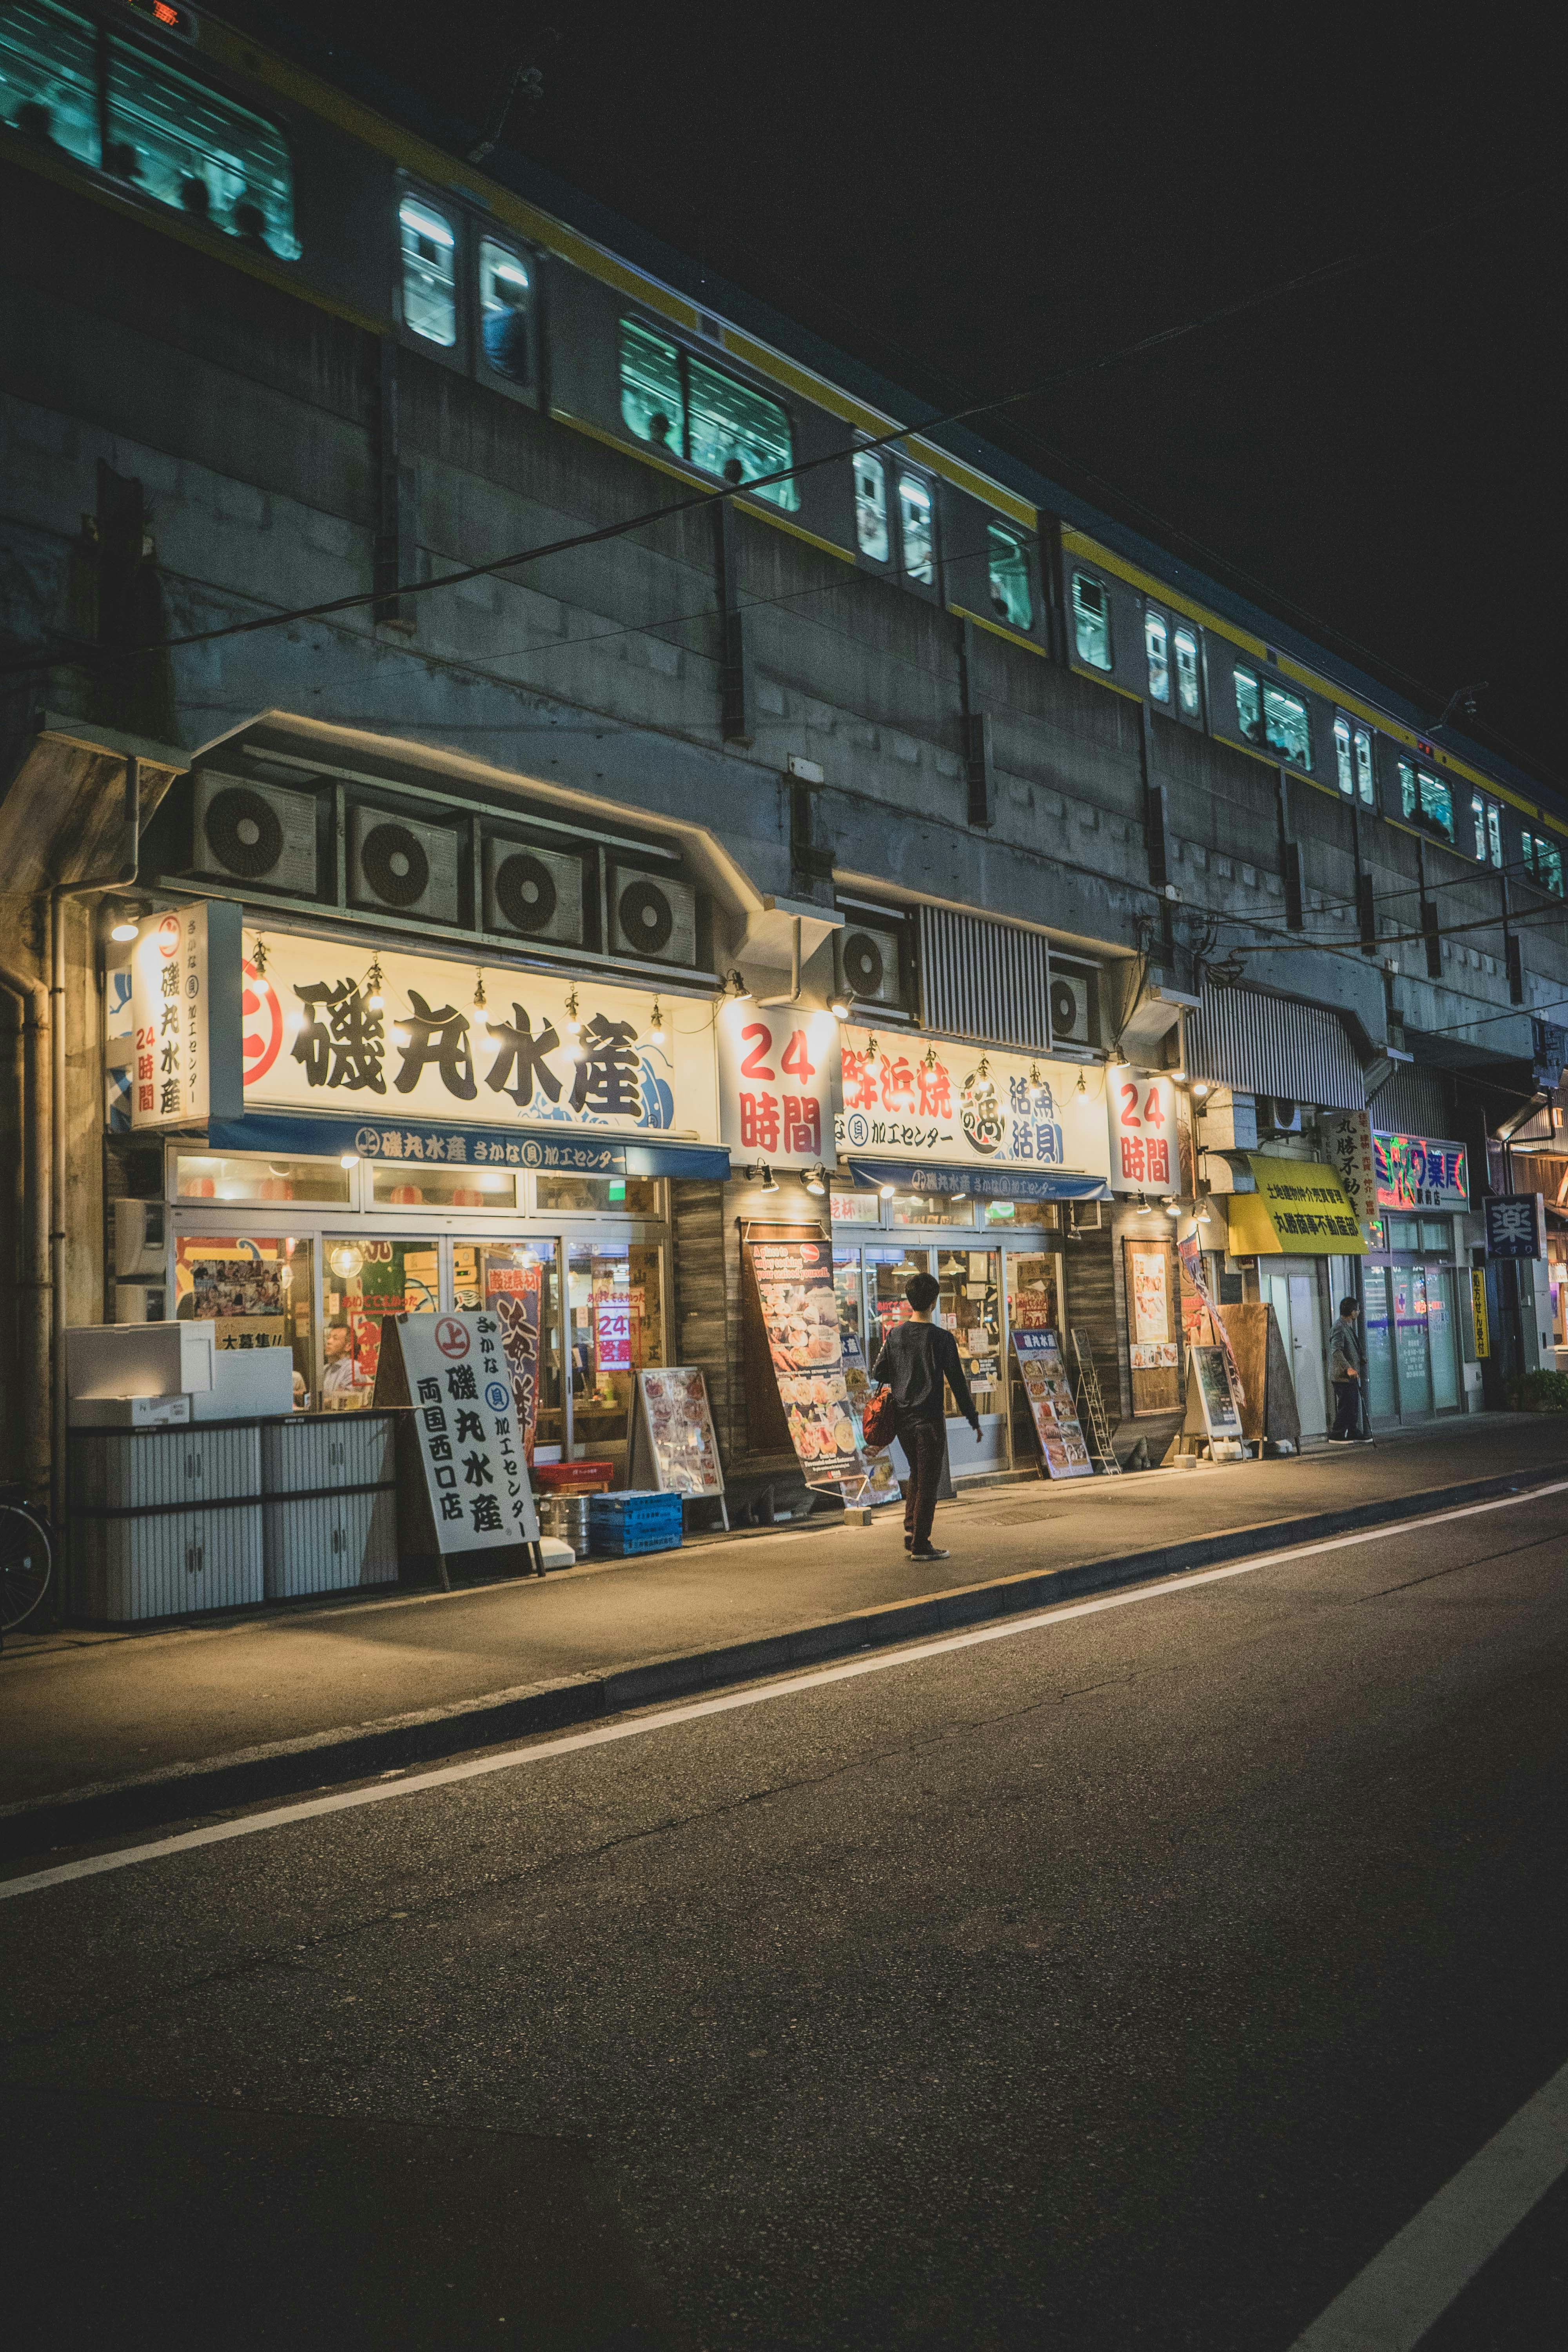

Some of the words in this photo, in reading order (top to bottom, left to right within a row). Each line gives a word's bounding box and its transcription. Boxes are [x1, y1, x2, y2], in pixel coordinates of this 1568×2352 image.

[160, 962, 181, 1116] 磯丸水産
[290, 977, 642, 1117] 磯丸水産
[741, 1023, 816, 1085] 24
[739, 1091, 822, 1156] 時間
[1120, 1082, 1165, 1131] 24
[1120, 1135, 1170, 1185] 時間
[1491, 1202, 1532, 1242] 薬
[1495, 1245, 1533, 1255] くすり
[755, 1258, 775, 1270] enjoy
[757, 1270, 773, 1281] your
[1474, 1274, 1484, 1355] 処方せん受付
[417, 1377, 465, 1521] 両国西口店
[445, 1364, 505, 1534] 磯丸水産
